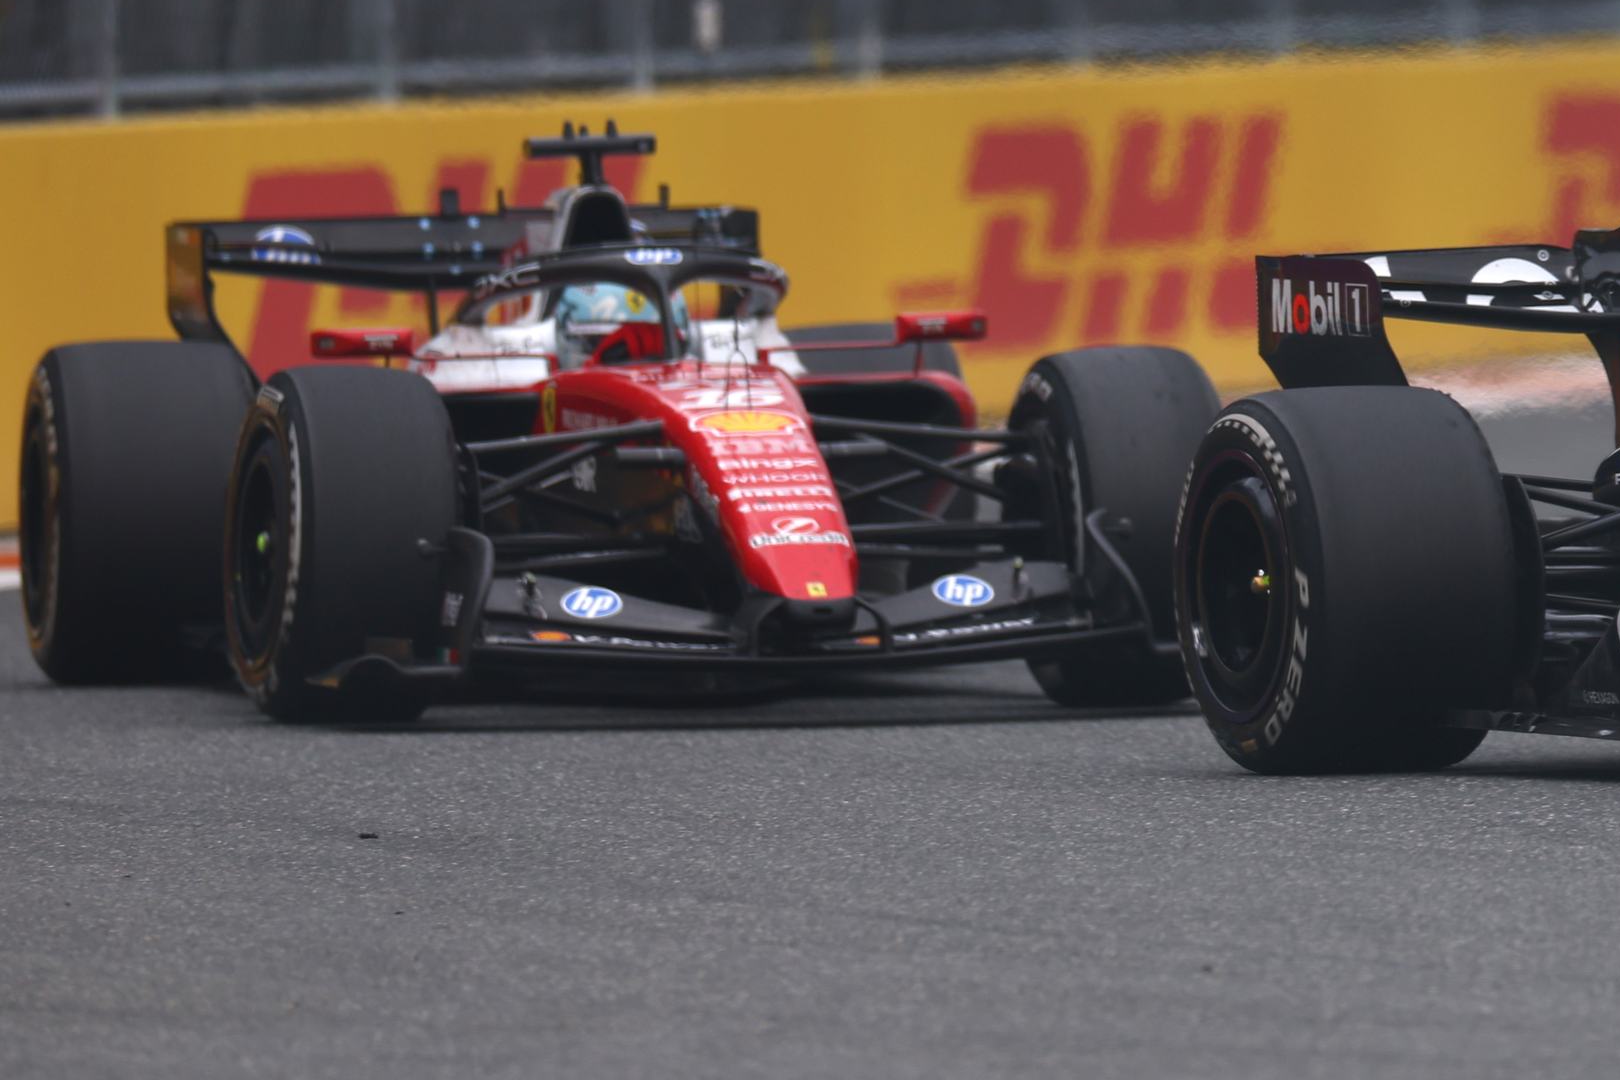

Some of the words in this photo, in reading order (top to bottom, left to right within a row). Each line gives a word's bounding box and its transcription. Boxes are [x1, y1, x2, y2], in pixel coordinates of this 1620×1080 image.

[965, 110, 1290, 354] DHL
[1271, 278, 1343, 336] Mobil
[569, 587, 614, 617] hp
[943, 576, 988, 605] hp
[1294, 567, 1310, 609] P
[1264, 616, 1308, 747] ZERO
